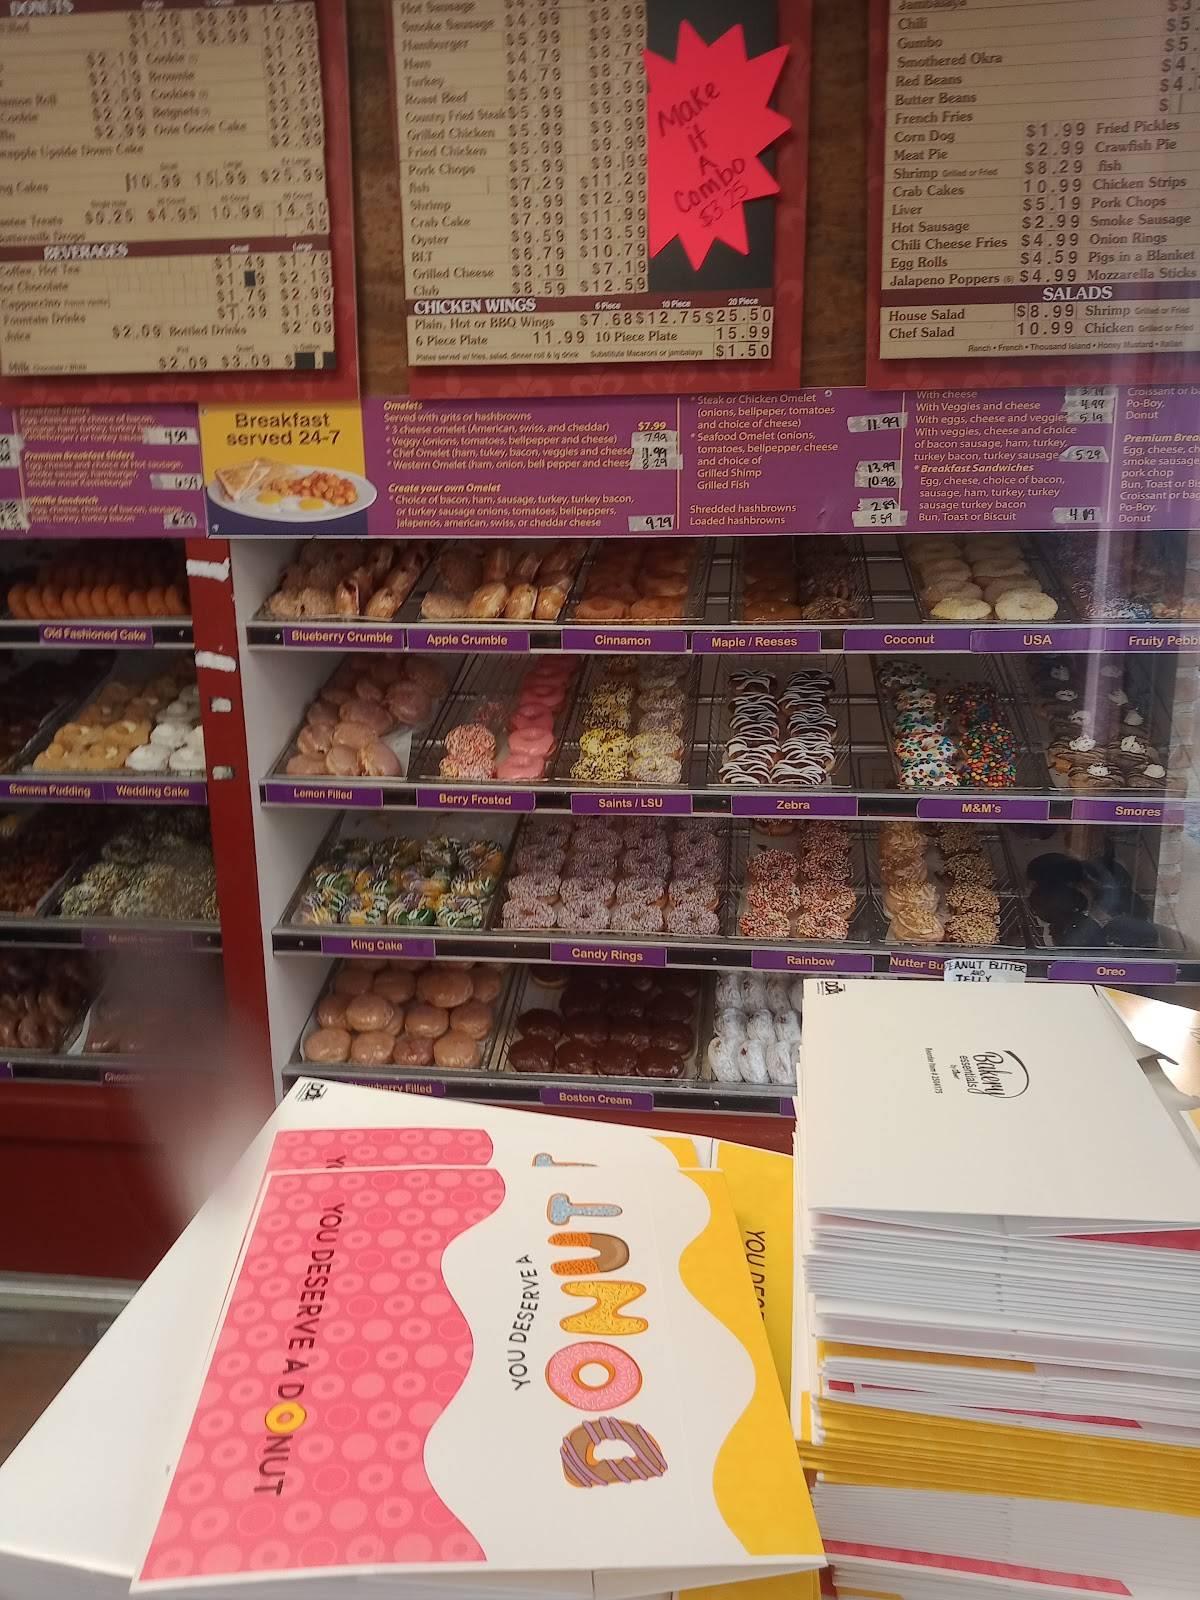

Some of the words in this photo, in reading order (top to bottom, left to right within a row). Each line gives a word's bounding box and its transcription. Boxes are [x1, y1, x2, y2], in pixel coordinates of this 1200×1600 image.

[658, 82, 720, 138] Make
[895, 112, 938, 125] French
[941, 111, 973, 123] Fries
[894, 131, 925, 143] Corn
[929, 130, 955, 144] Dog
[1026, 122, 1086, 138] $1.99
[1095, 121, 1129, 135] Fried
[1135, 119, 1180, 133] Pickles
[893, 150, 925, 162] Meat
[1095, 140, 1151, 154] Crawfish
[893, 167, 938, 181] Shrimp
[673, 158, 745, 213] Combo
[1092, 178, 1144, 191] Chicken
[1149, 175, 1187, 190] Strips
[1091, 197, 1122, 208] Pork
[1126, 195, 1166, 208] Chops
[891, 222, 914, 234] Hot
[918, 221, 970, 234] Sausage
[1090, 215, 1134, 227] Smoke
[1138, 214, 1191, 227] Sausage
[927, 239, 972, 249] Cheese
[976, 237, 1008, 248] Fries
[1021, 233, 1079, 248] $4.99
[1089, 234, 1128, 245] Onion
[1132, 233, 1168, 245] Rings
[890, 258, 913, 271] Egg
[918, 256, 948, 268] Rolls
[949, 273, 1000, 286] Poppers
[1019, 269, 1078, 284] $4.99
[1042, 286, 1113, 301] SALADS
[413, 299, 482, 316] CHICKEN
[484, 298, 537, 313] WINGS
[889, 310, 927, 322] House
[931, 309, 965, 320] Salad
[1016, 304, 1075, 319] $8.99
[1085, 305, 1130, 318] Shrimp
[519, 315, 555, 329] Wings
[425, 334, 456, 346] Piece
[458, 333, 489, 346] Plate
[532, 330, 586, 345] 11.99
[595, 331, 610, 343] 10
[613, 330, 645, 343] Piece
[647, 329, 678, 342] Plate
[715, 326, 771, 341] 15.99
[889, 328, 919, 339] Chef
[920, 326, 955, 338] Salad
[1016, 322, 1074, 337] 10.99
[1084, 322, 1134, 334] Chicken
[715, 343, 770, 358] $1.50
[916, 402, 939, 412] With
[941, 402, 981, 413] Veggies
[982, 401, 1002, 410] and
[1004, 401, 1041, 410] cheese
[234, 412, 331, 429] Breakfast
[638, 422, 666, 431] $7.99
[867, 417, 899, 430] 11.99
[697, 432, 737, 442] Seafood
[739, 431, 775, 440] Omelet
[915, 427, 938, 437] With
[983, 427, 1019, 436] cheese
[1021, 426, 1041, 435] and
[1043, 425, 1077, 434] choice
[227, 431, 294, 447] served
[299, 430, 341, 446] 24-7
[697, 456, 716, 466] and
[718, 456, 750, 465] choice
[868, 462, 895, 473] 13.99
[697, 468, 729, 478] Grilled
[921, 463, 970, 474] Breakfast
[972, 463, 1034, 473] Sandwiches
[466, 482, 501, 492] Omelet
[697, 480, 729, 489] Grilled
[731, 480, 750, 489] Fish
[868, 476, 896, 488] 10.98
[983, 476, 1018, 485] choice
[690, 504, 737, 514] Shredded
[738, 503, 797, 513] hashbrowns
[690, 516, 726, 526] Loaded
[727, 515, 785, 525] hashbrowns
[943, 512, 969, 522] Toast
[983, 512, 1016, 521] Biscuit
[119, 630, 147, 641] Cake
[291, 630, 345, 644] Blueberry
[347, 632, 393, 644] Crumble
[426, 633, 458, 647] Apple
[461, 634, 508, 645] Crumble
[594, 634, 652, 646] Cinnamon
[883, 634, 935, 646] Coconut
[1023, 634, 1052, 647] USA
[1129, 636, 1164, 648] Fruity
[711, 637, 746, 650] Maple
[755, 636, 798, 647] Reeses
[8, 784, 47, 796] Banana
[49, 784, 91, 799] Pudding
[116, 785, 161, 799] Wedding
[162, 786, 190, 798] Cake
[292, 787, 326, 799] Lemon
[328, 788, 353, 800] Filled
[439, 794, 469, 808] Berry
[471, 794, 512, 806] Frosted
[598, 798, 631, 809] Saints
[640, 797, 664, 809] LSU
[776, 799, 811, 810] Zebra
[961, 803, 1002, 814] M&M's
[1115, 806, 1161, 818] Smores
[350, 940, 375, 952] King
[377, 940, 403, 951] Cake
[571, 948, 609, 962] Candy
[610, 949, 643, 963] Rings
[786, 955, 836, 967] Rainbow
[889, 957, 926, 969] Nutter
[989, 961, 1026, 973] BUTTER
[1096, 966, 1126, 977] Oreo
[960, 1055, 979, 1088] essentials
[967, 1052, 1013, 1096] Bakery
[406, 1083, 432, 1093] Filled
[558, 1092, 596, 1104] Boston
[597, 1094, 632, 1106] Cream
[315, 1202, 346, 1243] YOU
[745, 1230, 766, 1268] YOU
[515, 1253, 532, 1264] A
[288, 1249, 335, 1351] DESERVE
[509, 1268, 539, 1346] DESERVE
[544, 1192, 668, 1488] DONUT
[282, 1358, 309, 1375] A
[508, 1349, 531, 1391] YOU
[254, 1383, 307, 1496] DONUT
